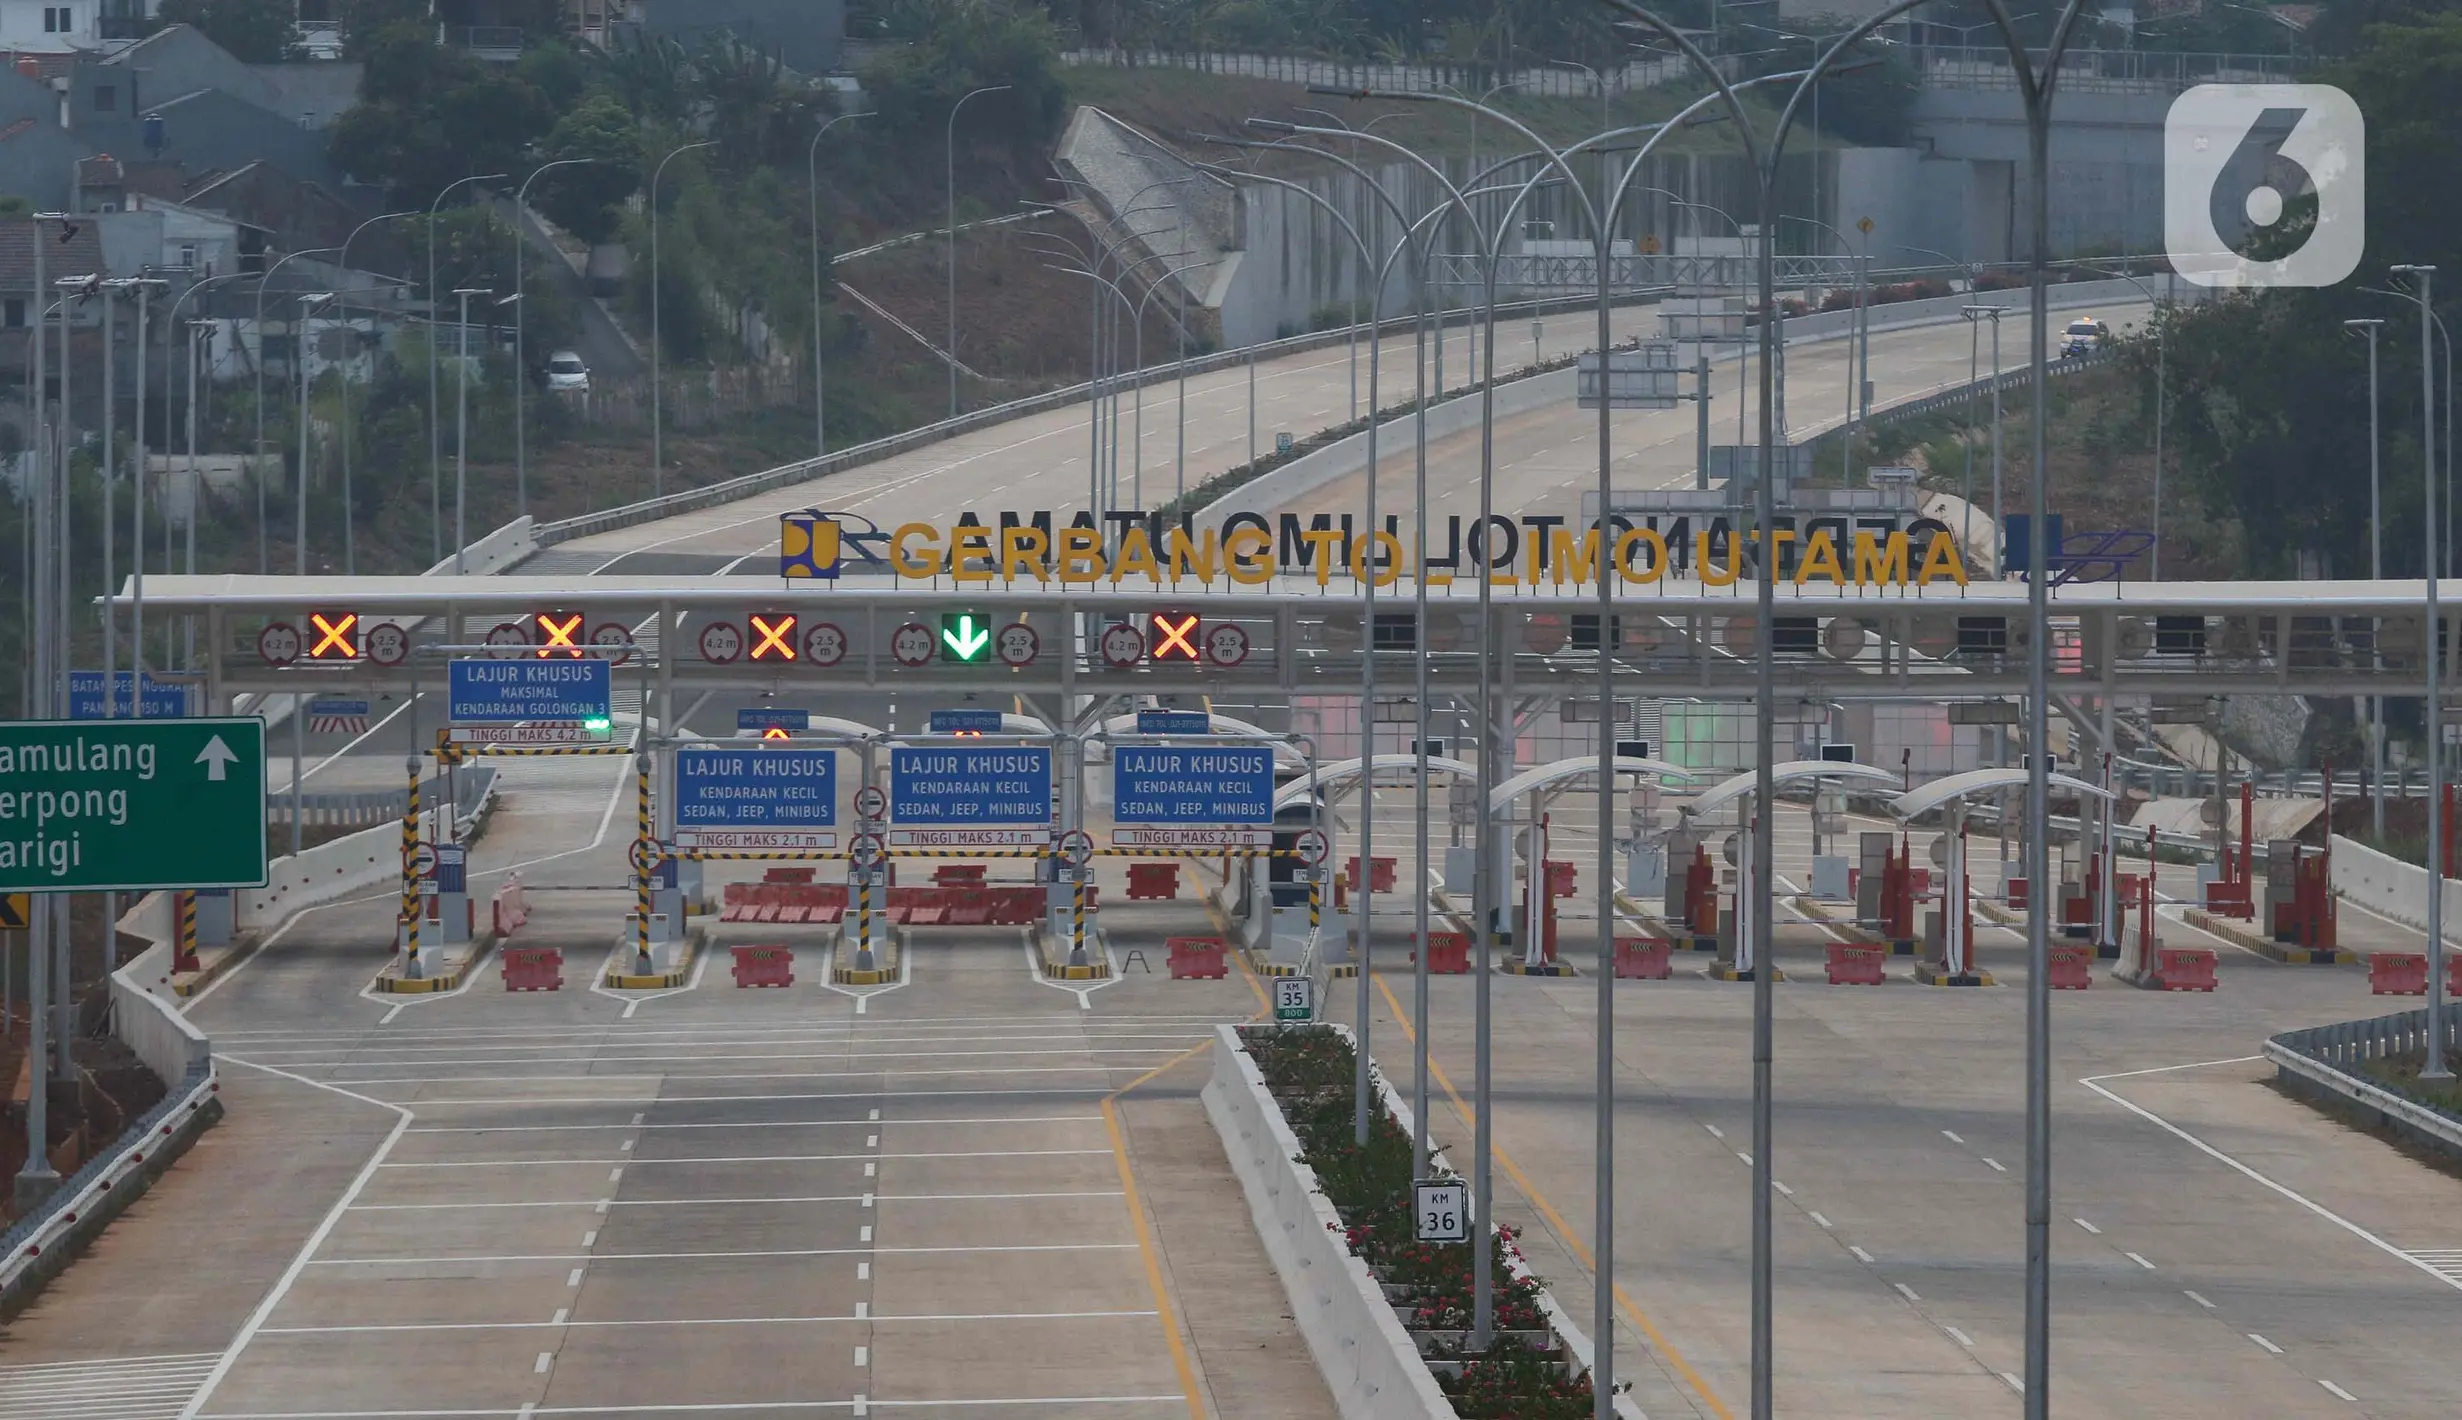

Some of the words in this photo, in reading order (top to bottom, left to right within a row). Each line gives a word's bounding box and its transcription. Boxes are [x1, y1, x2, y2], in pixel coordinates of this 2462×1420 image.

[890, 523, 1275, 584] GERBANG
[1301, 530, 1452, 586] TOL
[1697, 531, 1969, 586] UTAMA
[285, 641, 295, 649] m
[378, 636, 396, 645] 2.5
[706, 639, 722, 649] 4.2
[724, 640, 736, 648] m
[816, 636, 834, 646] 2.5
[916, 642, 928, 650] m
[1009, 636, 1027, 646] 2.5
[1108, 641, 1125, 651] 4.2
[1127, 642, 1138, 650] m
[1219, 636, 1236, 646] 2.5
[820, 648, 831, 657] m
[1013, 648, 1023, 657] m
[1222, 649, 1232, 658] m
[467, 666, 518, 682] LAJUR
[527, 666, 592, 682] KHUSUS
[501, 687, 559, 699] MAKSIMAL
[82, 702, 132, 714] PANANG
[455, 703, 524, 715] KENDARAAN
[529, 703, 593, 715] GOLONGAN
[599, 703, 605, 715] 3
[469, 730, 512, 741] TINGGI
[518, 730, 552, 741] MAKS
[580, 732, 591, 740] m
[0, 737, 156, 780] amulang
[901, 756, 958, 773] LAJUR
[967, 755, 1040, 773] KHUSUS
[1124, 756, 1181, 773] LAJUR
[1191, 756, 1264, 773] KHUSUS
[686, 759, 743, 776] LAJUR
[753, 759, 826, 776] KHUSUS
[700, 787, 777, 799] KENDARAAN
[783, 787, 818, 799] KECIL
[912, 782, 990, 794] KENDARAAN
[996, 782, 1031, 794] KECIL
[1135, 781, 1212, 794] KENDARAAN
[1219, 781, 1252, 793] KECIL
[0, 789, 127, 827] erpong
[684, 805, 731, 819] SEDAN,
[736, 805, 769, 819] JEEP,
[775, 805, 828, 818] MINIBUS
[898, 803, 944, 817] SEDAN,
[949, 803, 983, 817] JEEP,
[989, 803, 1043, 815] MINIBUS
[1121, 802, 1168, 816] SEDAN,
[1173, 802, 1206, 816] JEEP,
[1212, 802, 1266, 815] MINIBUS
[695, 834, 737, 845] TINGGI
[743, 834, 777, 845] MAKS
[806, 836, 817, 845] m
[909, 832, 952, 843] TINGGI
[958, 832, 992, 843] MAKS
[1020, 834, 1031, 843] m
[1132, 831, 1175, 843] TINGGI
[1181, 831, 1215, 843] MAKS
[1244, 834, 1254, 842] m
[0, 831, 81, 876] arigi
[1286, 983, 1299, 991] KM
[1283, 992, 1303, 1006] 35
[1432, 1194, 1449, 1204] KM
[1427, 1212, 1455, 1231] 36
